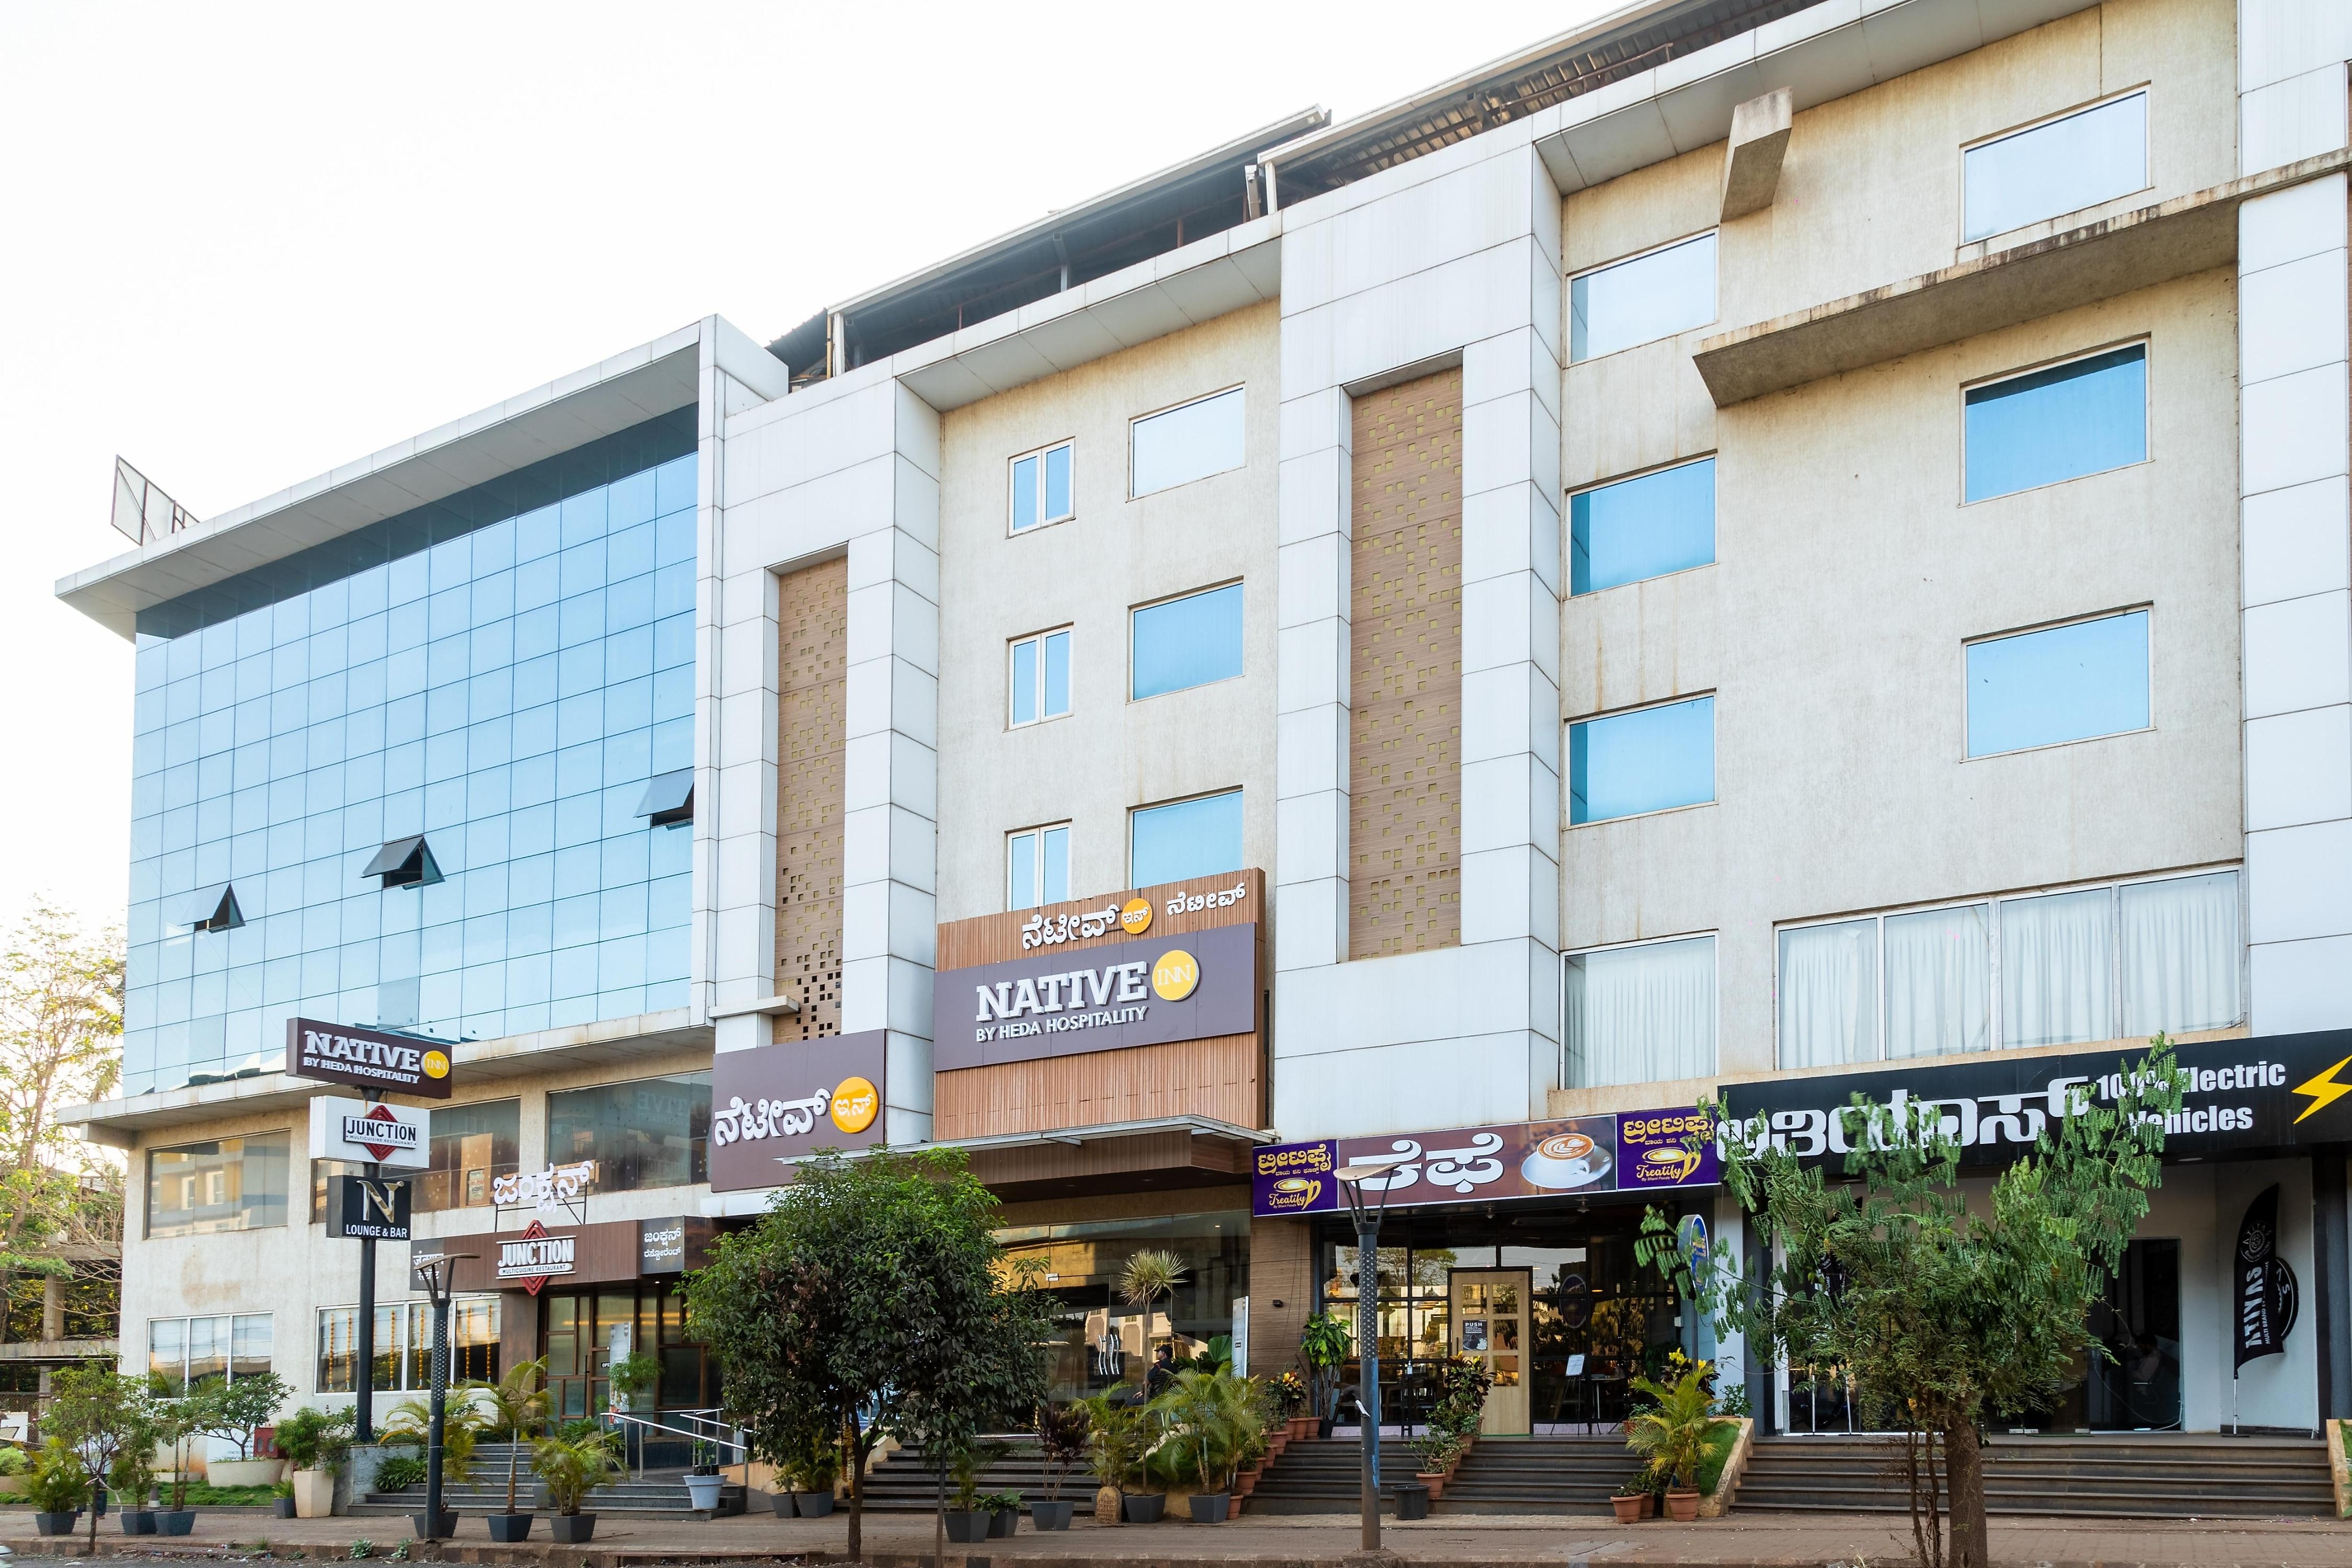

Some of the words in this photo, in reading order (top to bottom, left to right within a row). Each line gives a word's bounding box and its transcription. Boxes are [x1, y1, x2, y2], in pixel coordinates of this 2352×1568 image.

[1122, 907, 1150, 924] ಇನ್
[976, 961, 1148, 1022] NATIVE
[1157, 964, 1191, 986] INN
[976, 1026, 997, 1042] BY
[999, 1021, 1043, 1039] HEDA
[1046, 1006, 1149, 1033] HOSPITALITY
[304, 1030, 420, 1071] NATIVE
[426, 1058, 446, 1070] INN
[303, 1057, 320, 1067] BY
[320, 1059, 353, 1073] HEDA
[353, 1065, 420, 1084] HOSPITALITY
[834, 1093, 874, 1117] ಇನ್
[347, 1120, 417, 1142] JUNCTION
[1636, 1165, 1682, 1179] Treatify
[356, 1180, 405, 1224] N
[1269, 1193, 1307, 1206] Treatify
[345, 1224, 381, 1237] LOUNGE
[382, 1228, 388, 1237] &
[390, 1227, 407, 1238] BAR
[498, 1239, 575, 1267] JUNCTION
[2243, 1266, 2264, 1349] ATIYAS
